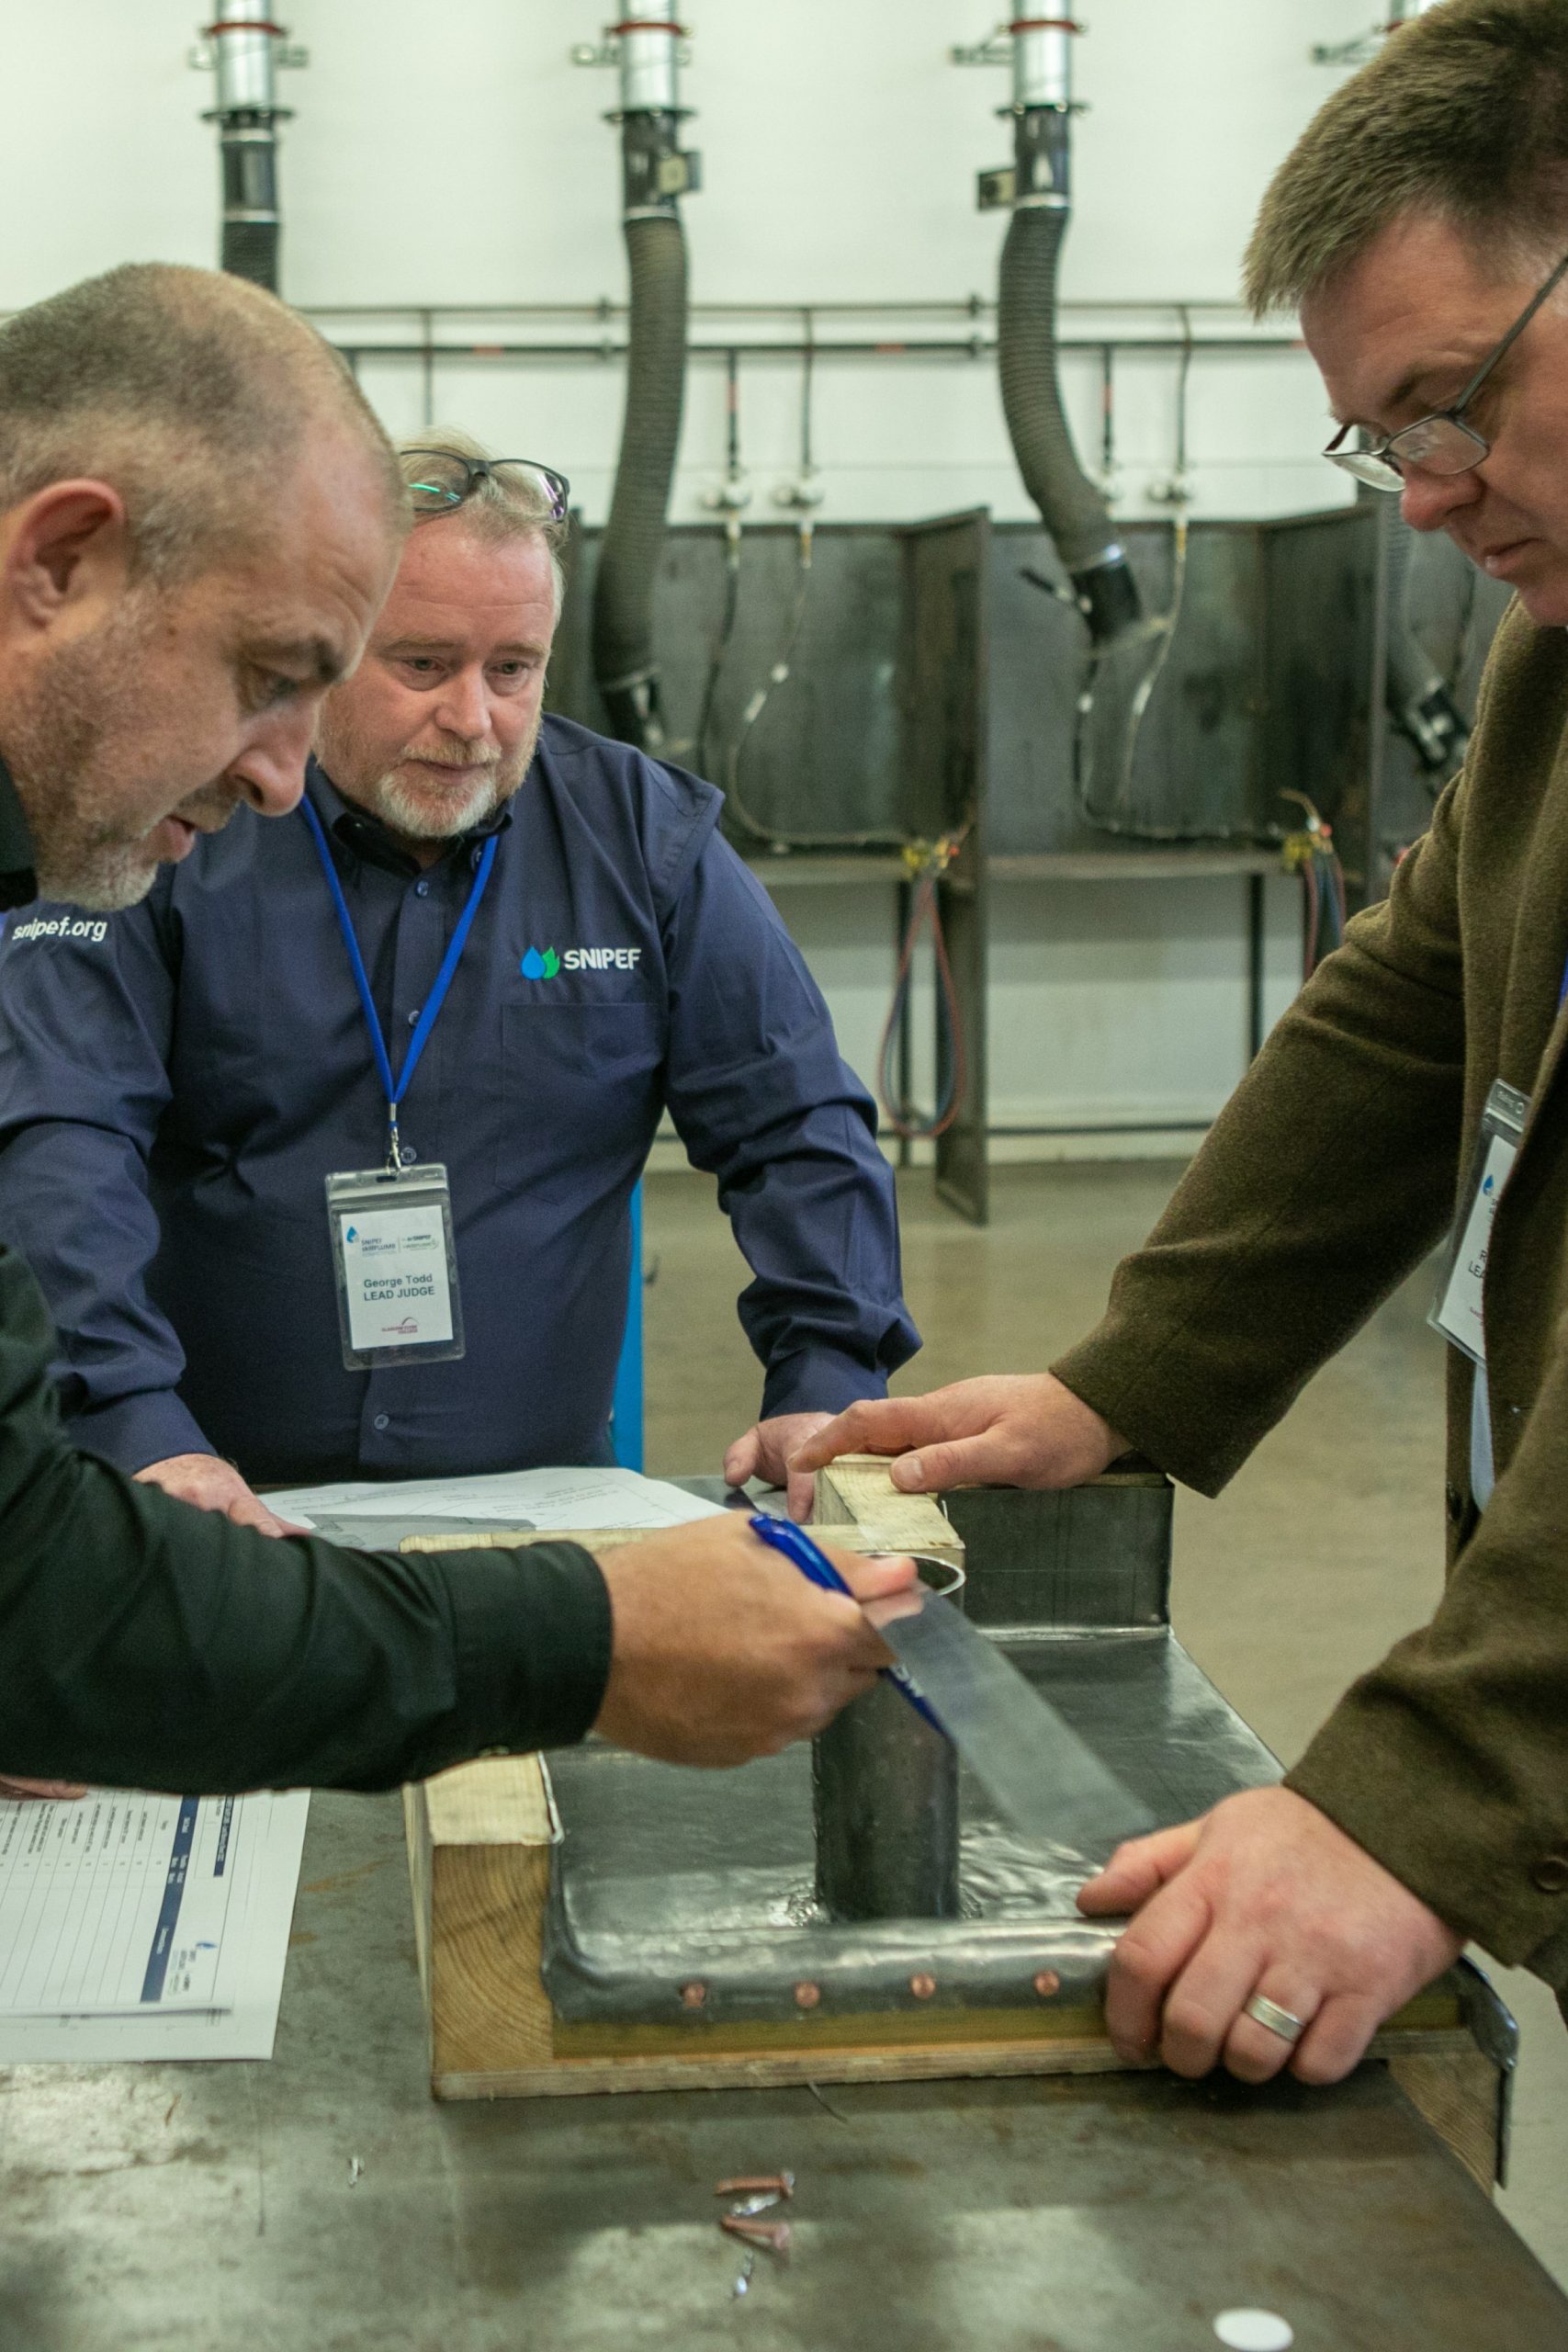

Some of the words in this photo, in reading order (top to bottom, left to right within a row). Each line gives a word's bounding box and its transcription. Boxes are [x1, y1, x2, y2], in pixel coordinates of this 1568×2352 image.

[11, 917, 107, 942] snipef.org
[563, 948, 642, 970] SNIPEF
[363, 1278, 403, 1288] George
[405, 1273, 434, 1284] Todd
[364, 1290, 394, 1302] LEAD
[397, 1285, 435, 1298] JUDGE
